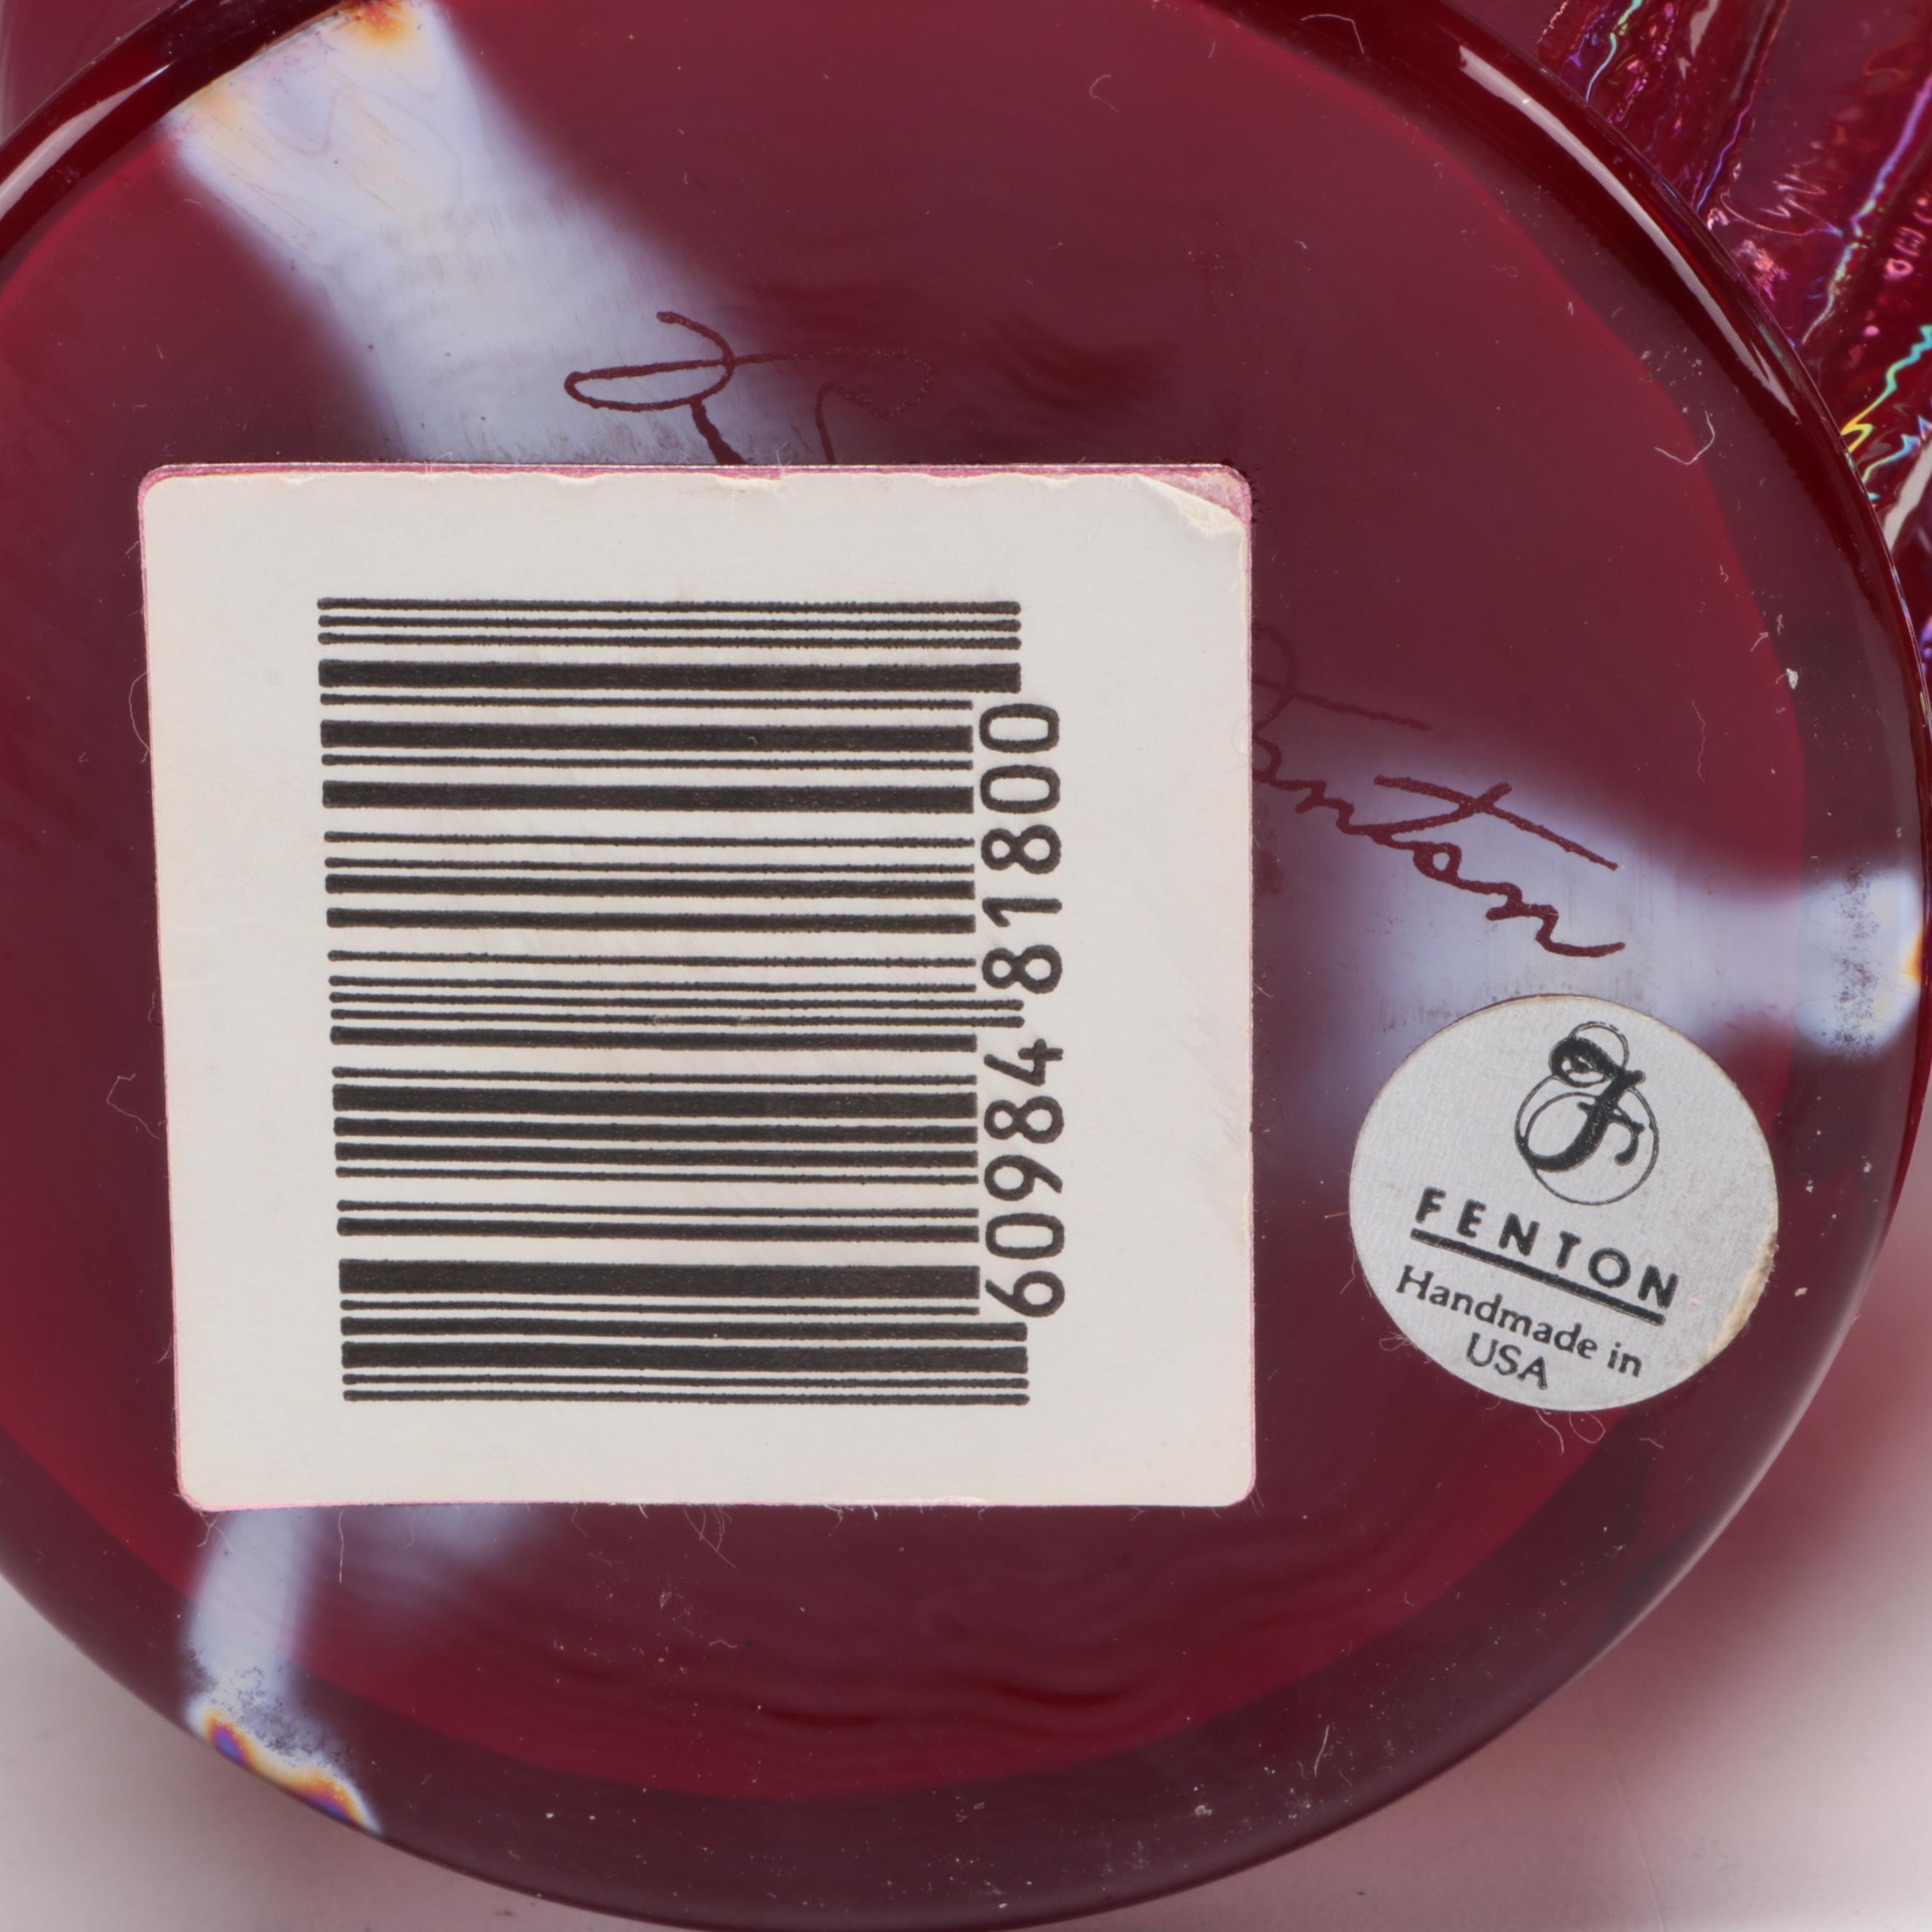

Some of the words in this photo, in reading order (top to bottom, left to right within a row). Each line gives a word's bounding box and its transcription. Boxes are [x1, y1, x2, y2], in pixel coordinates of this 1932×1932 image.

[978, 703, 1063, 994] 81800
[983, 1038, 1066, 1318] 60984
[1415, 1186, 1680, 1309] FENTON
[1396, 1264, 1598, 1360] Handmade
[1606, 1341, 1642, 1377] in
[1465, 1332, 1548, 1390] USA
